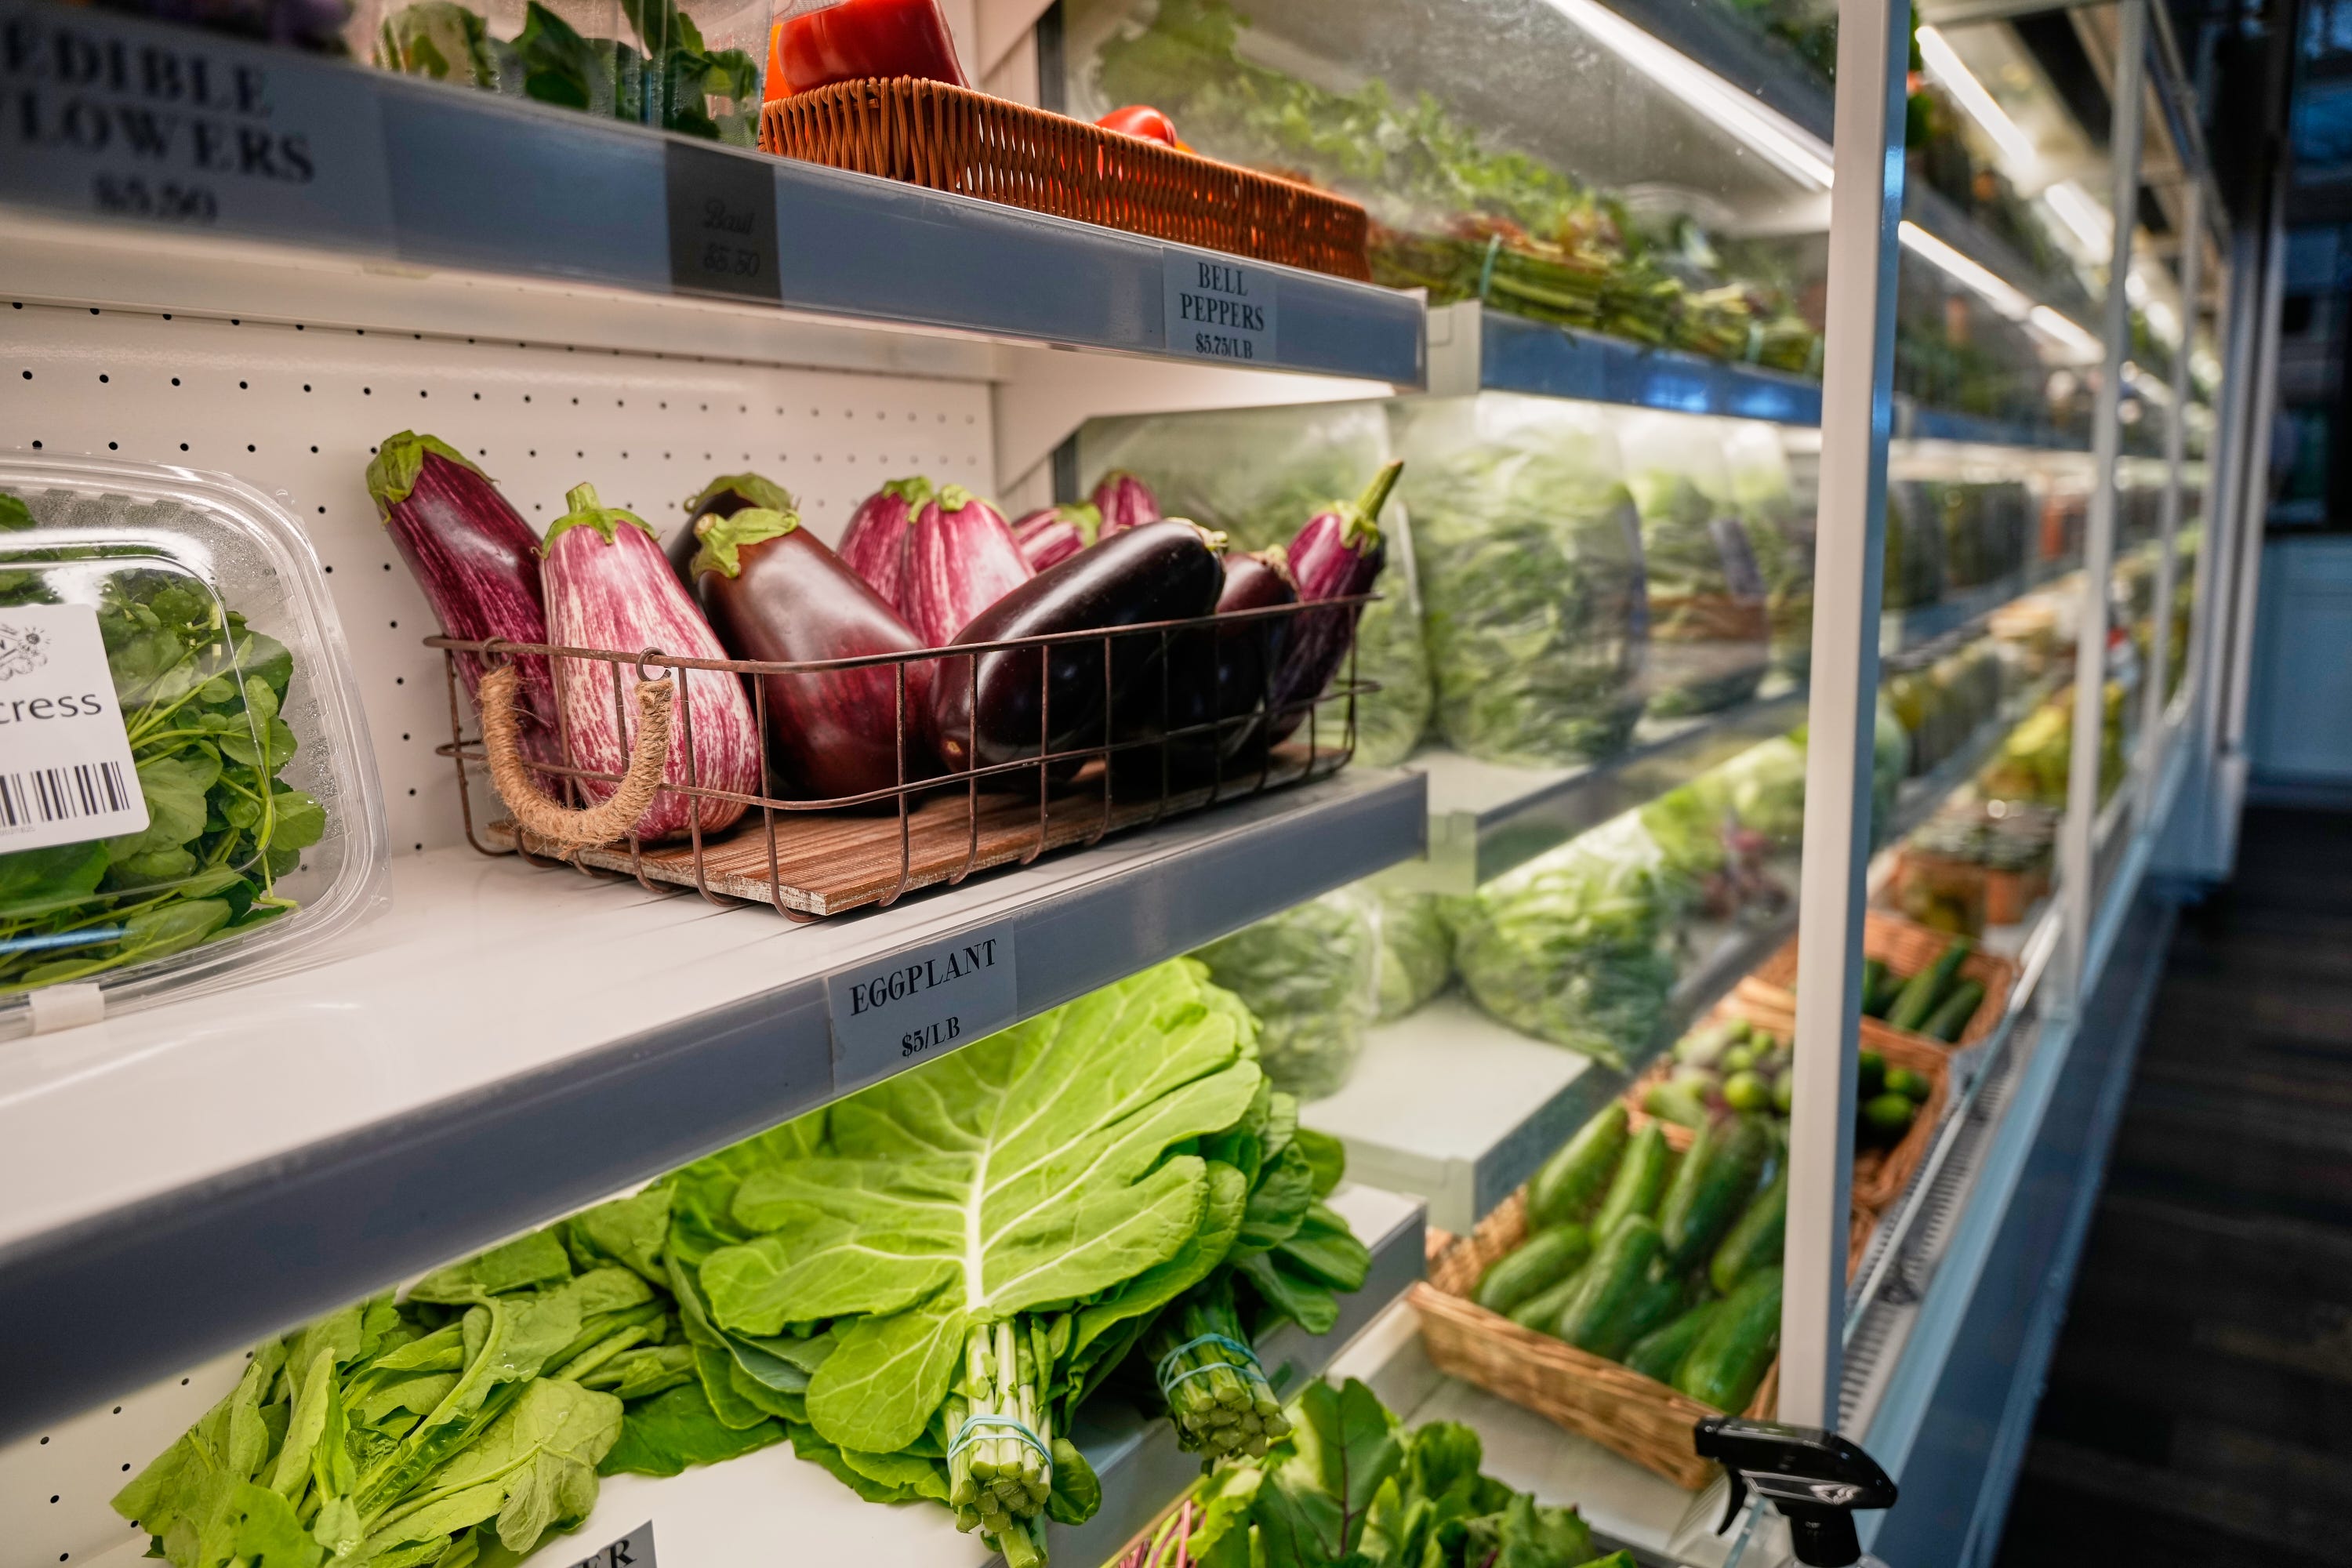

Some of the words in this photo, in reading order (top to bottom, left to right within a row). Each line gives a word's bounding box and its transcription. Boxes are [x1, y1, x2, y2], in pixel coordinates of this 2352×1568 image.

[3, 18, 274, 119] EDIBLE
[0, 88, 315, 185] LOWERS
[1197, 262, 1249, 296] BELL
[1179, 292, 1265, 332] PEPPERS
[1195, 330, 1253, 360] $5.75/LB
[848, 938, 997, 1017] EGGPLANT
[902, 1016, 960, 1058] $5/LB
